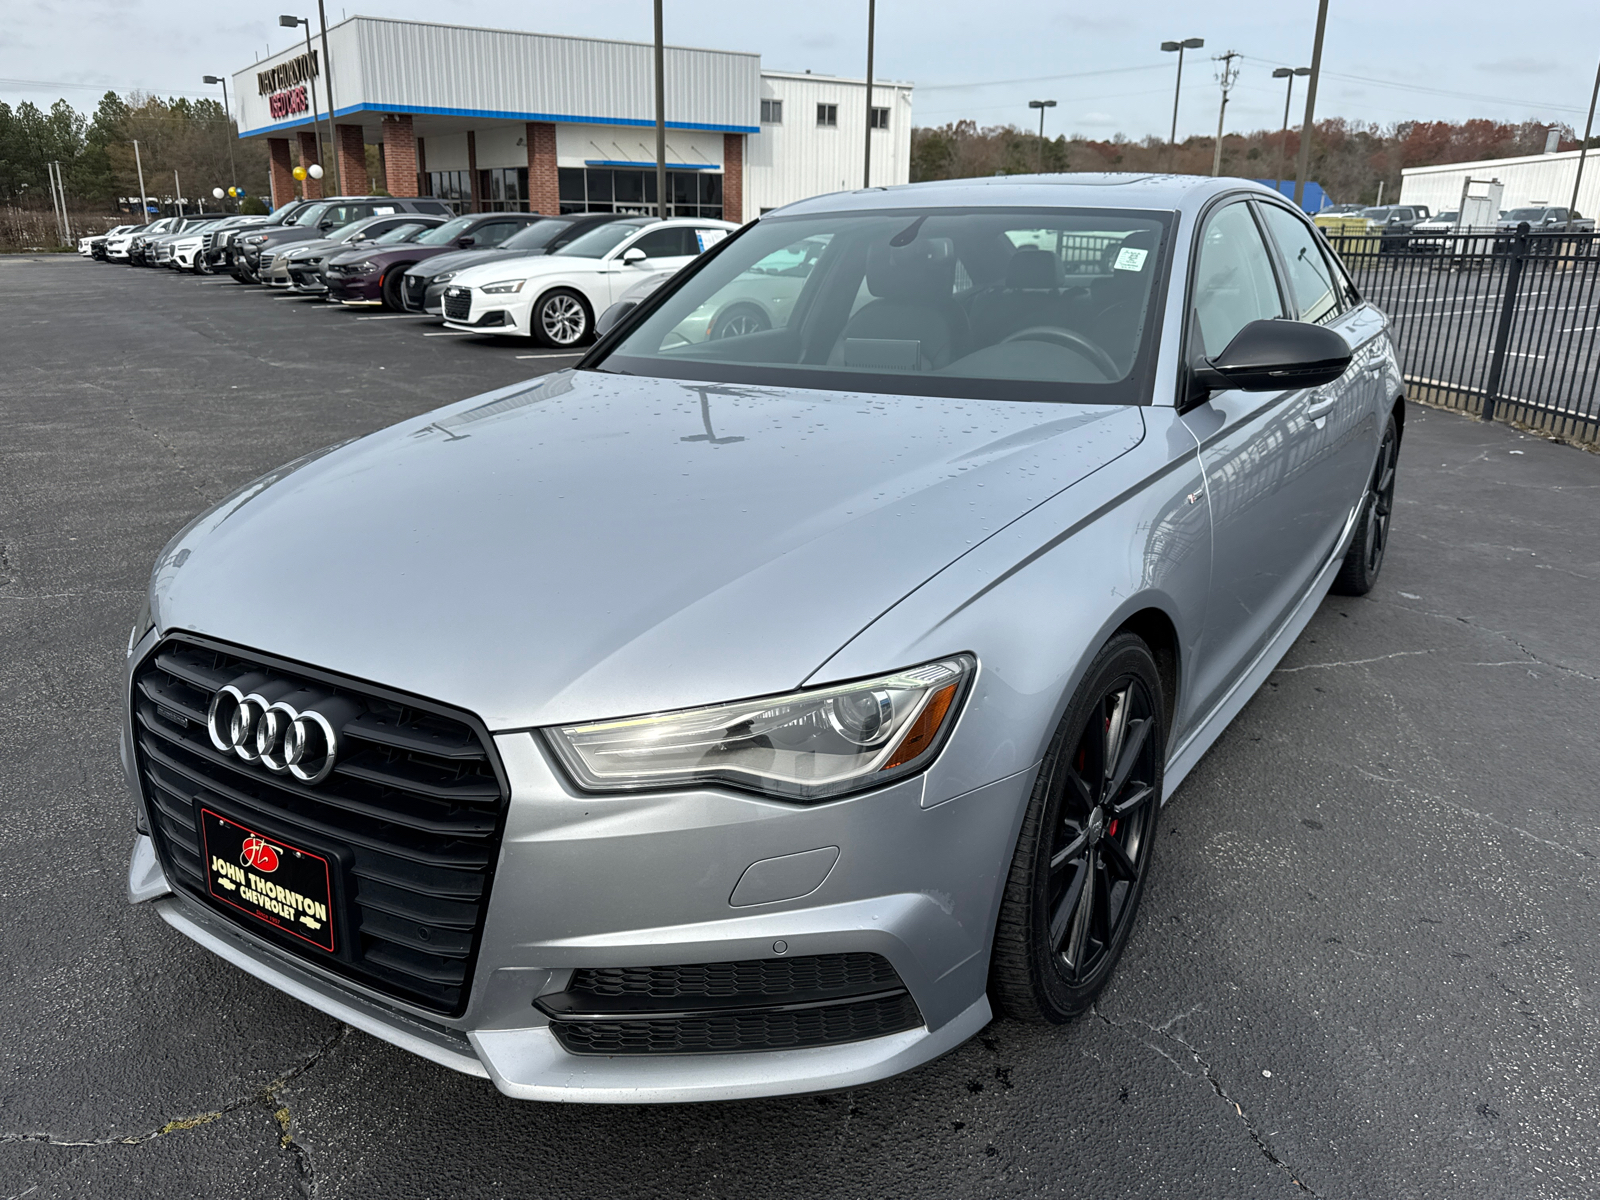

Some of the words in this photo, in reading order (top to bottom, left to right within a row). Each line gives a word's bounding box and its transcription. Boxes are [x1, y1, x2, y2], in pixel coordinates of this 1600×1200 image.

[269, 94, 287, 118] USED
[286, 86, 308, 114] CARS
[212, 855, 245, 885] JOHN
[248, 873, 326, 922] THORNTON
[240, 886, 295, 921] CHEVROLET
